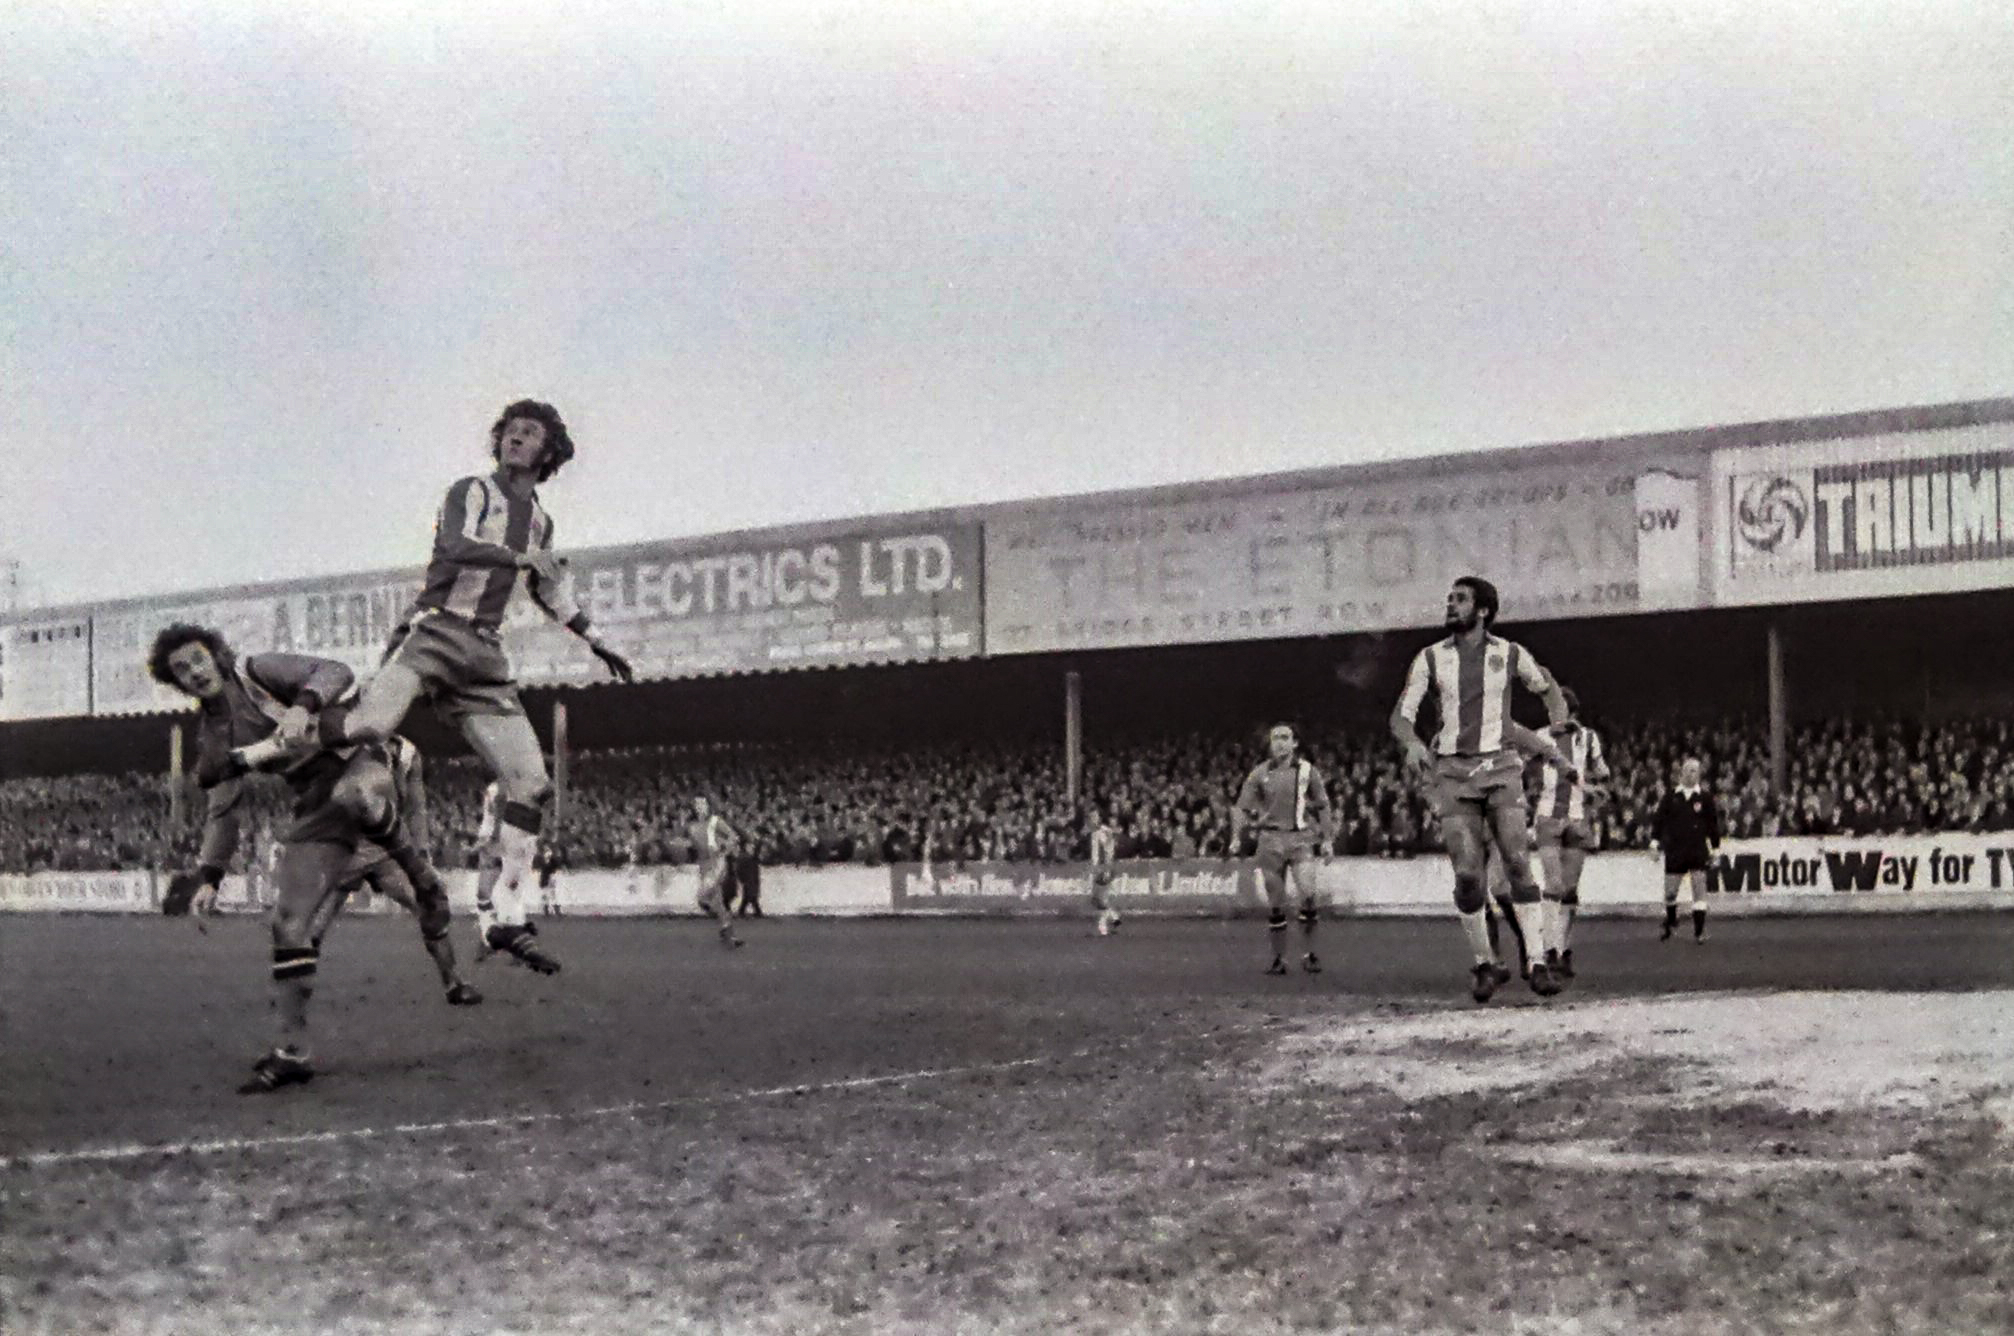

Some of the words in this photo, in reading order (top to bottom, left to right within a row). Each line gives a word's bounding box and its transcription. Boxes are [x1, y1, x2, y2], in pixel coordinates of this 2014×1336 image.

[591, 543, 840, 622] ELECTRICS
[859, 534, 962, 598] LTD.
[1048, 548, 1198, 607] THE
[1929, 847, 1975, 886] for
